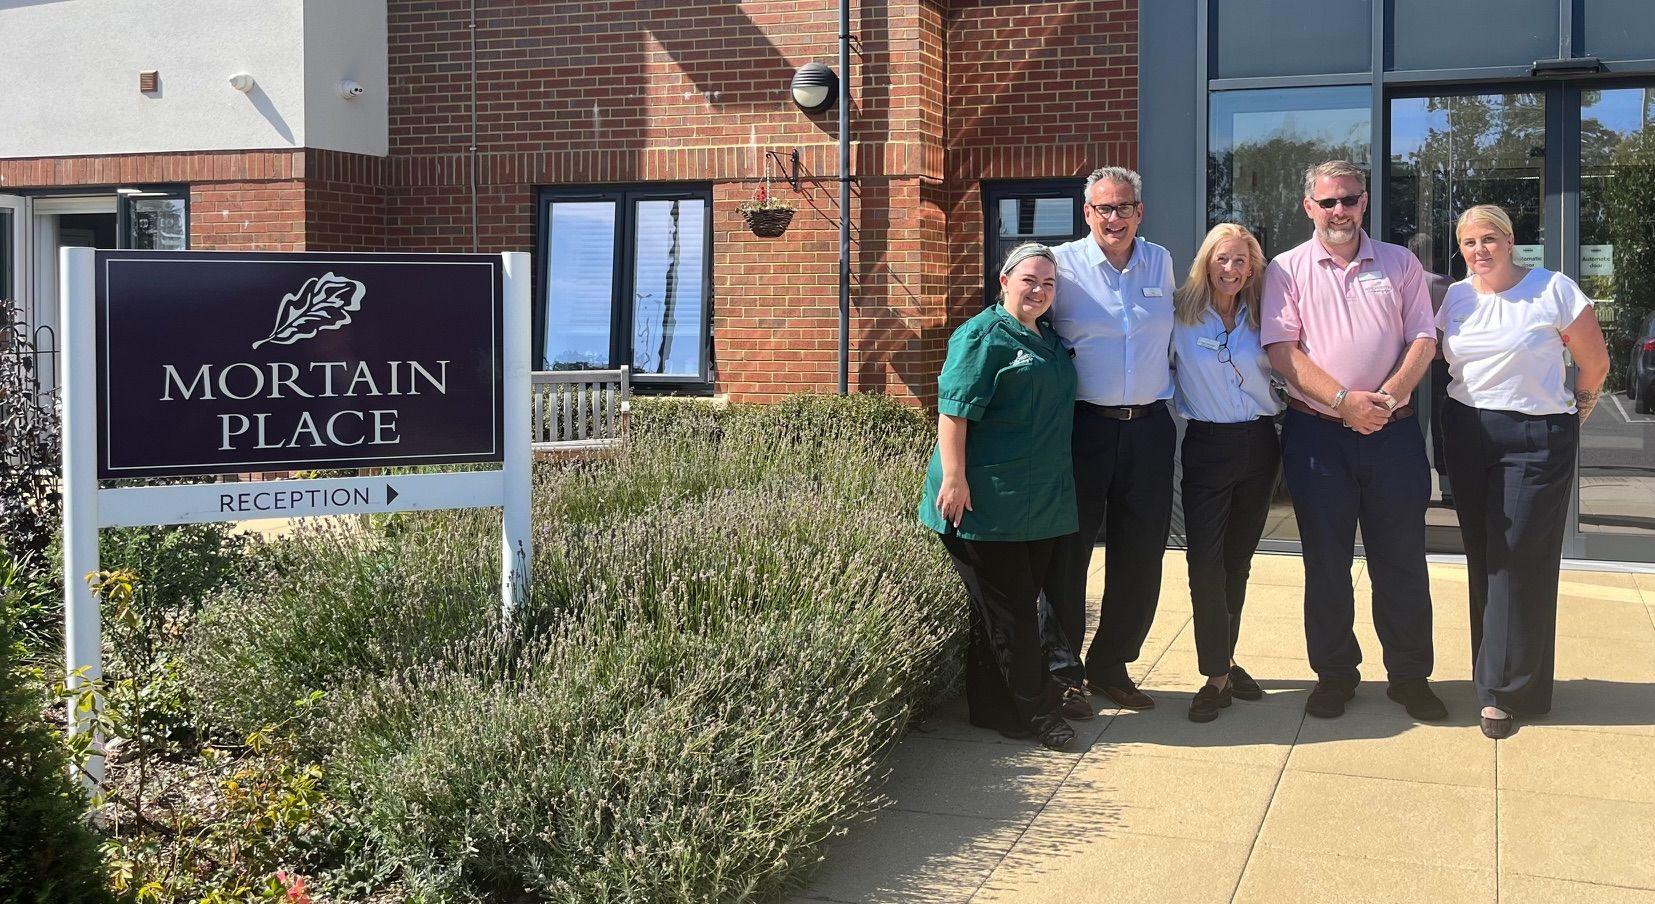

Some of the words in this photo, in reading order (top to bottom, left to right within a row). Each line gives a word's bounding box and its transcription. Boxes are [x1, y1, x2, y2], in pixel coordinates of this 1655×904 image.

[159, 360, 451, 401] MORTAIN
[217, 409, 401, 450] PLACE
[220, 487, 370, 512] RECEPTION
